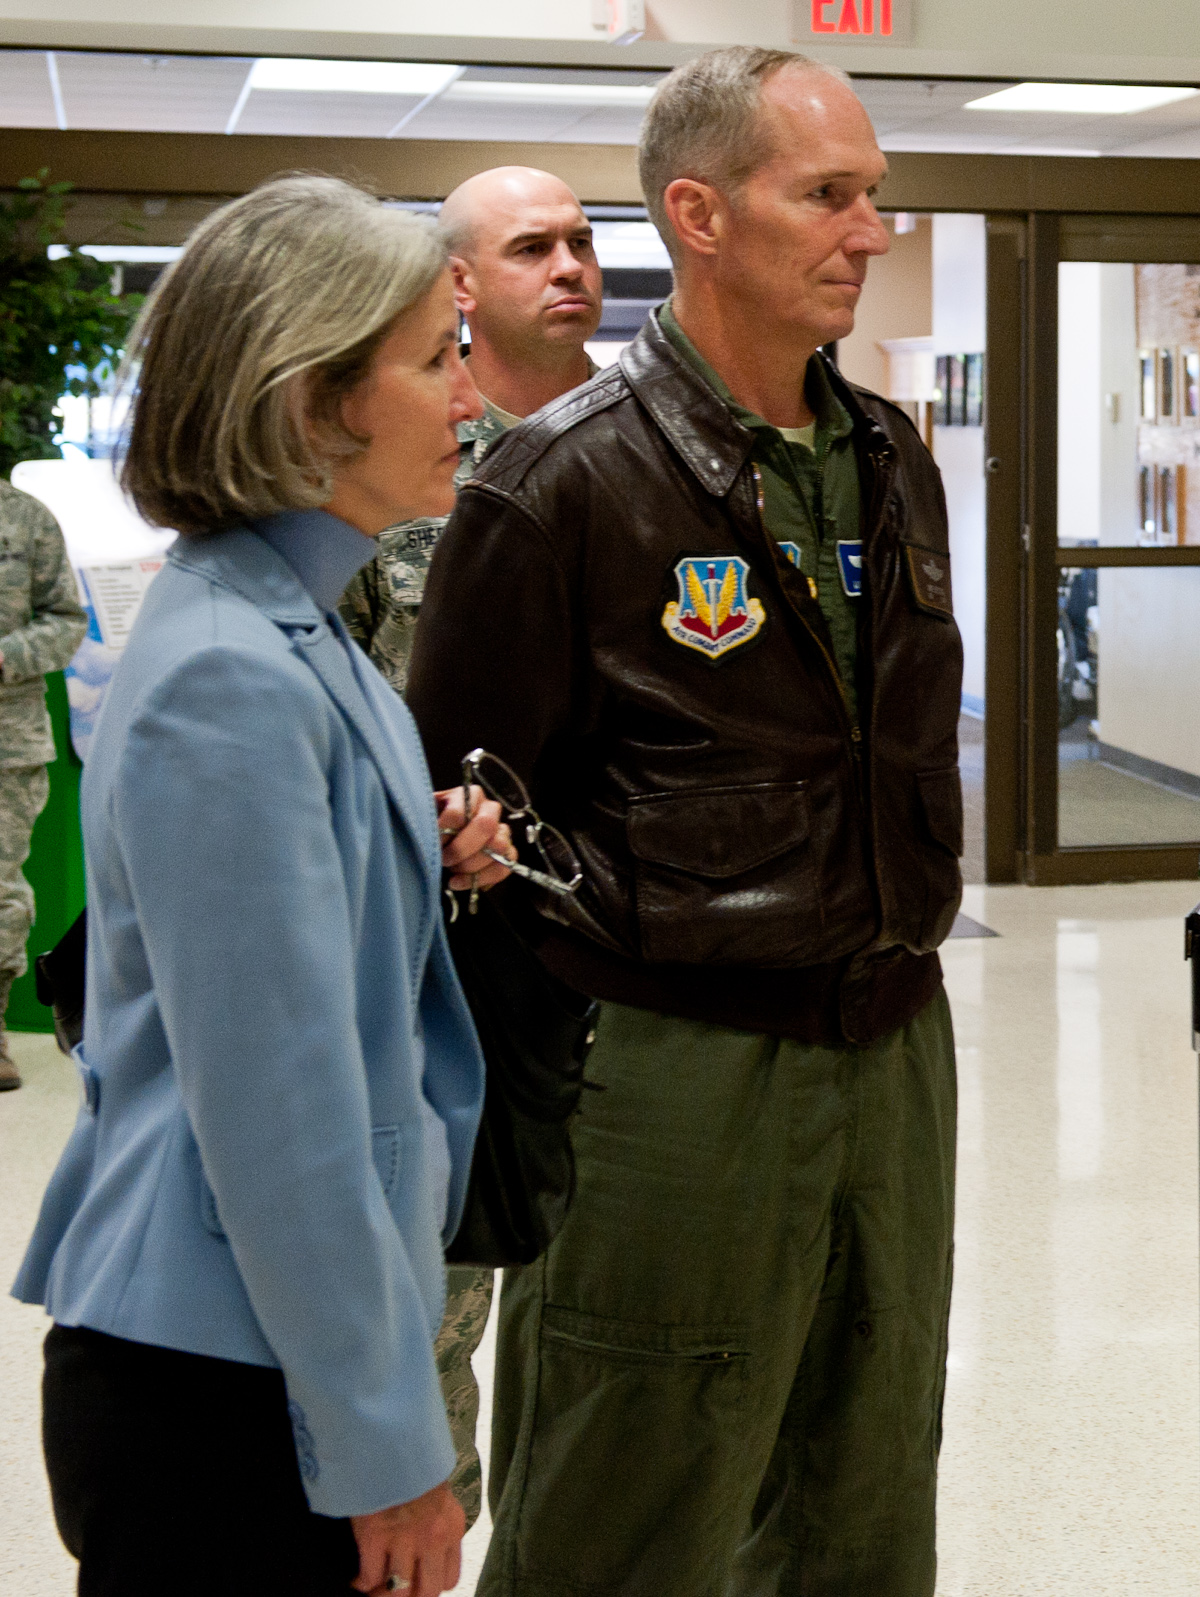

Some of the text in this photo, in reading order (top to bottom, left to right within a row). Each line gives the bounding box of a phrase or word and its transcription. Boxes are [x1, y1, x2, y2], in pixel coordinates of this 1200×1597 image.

[672, 617, 757, 652] AIR COMBAT COMMAND
